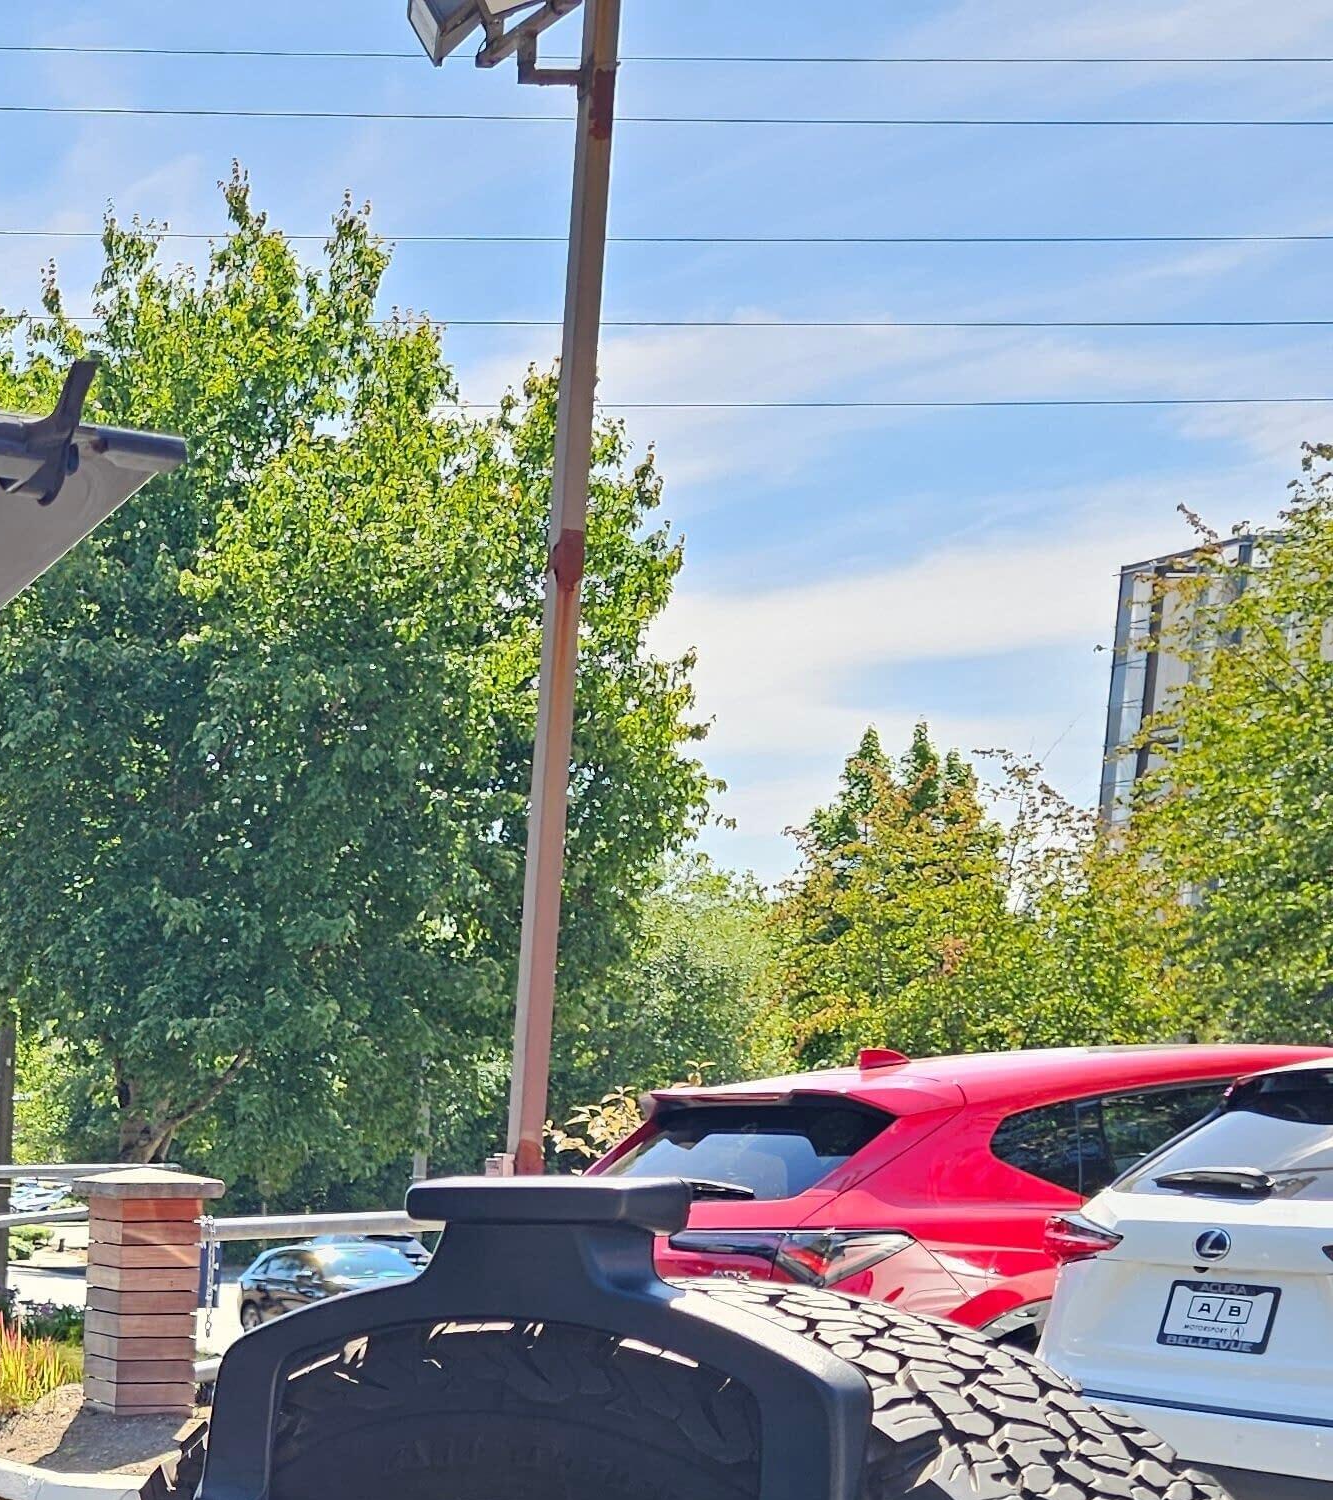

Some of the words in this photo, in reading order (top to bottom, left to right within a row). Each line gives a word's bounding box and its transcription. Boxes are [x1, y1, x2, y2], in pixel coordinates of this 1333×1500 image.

[1200, 1282, 1247, 1295] ACURA
[1198, 1303, 1211, 1314] A
[1228, 1305, 1241, 1317] B
[1183, 1323, 1228, 1334] MOTORSPORT
[1165, 1335, 1254, 1353] BELLEVUE
